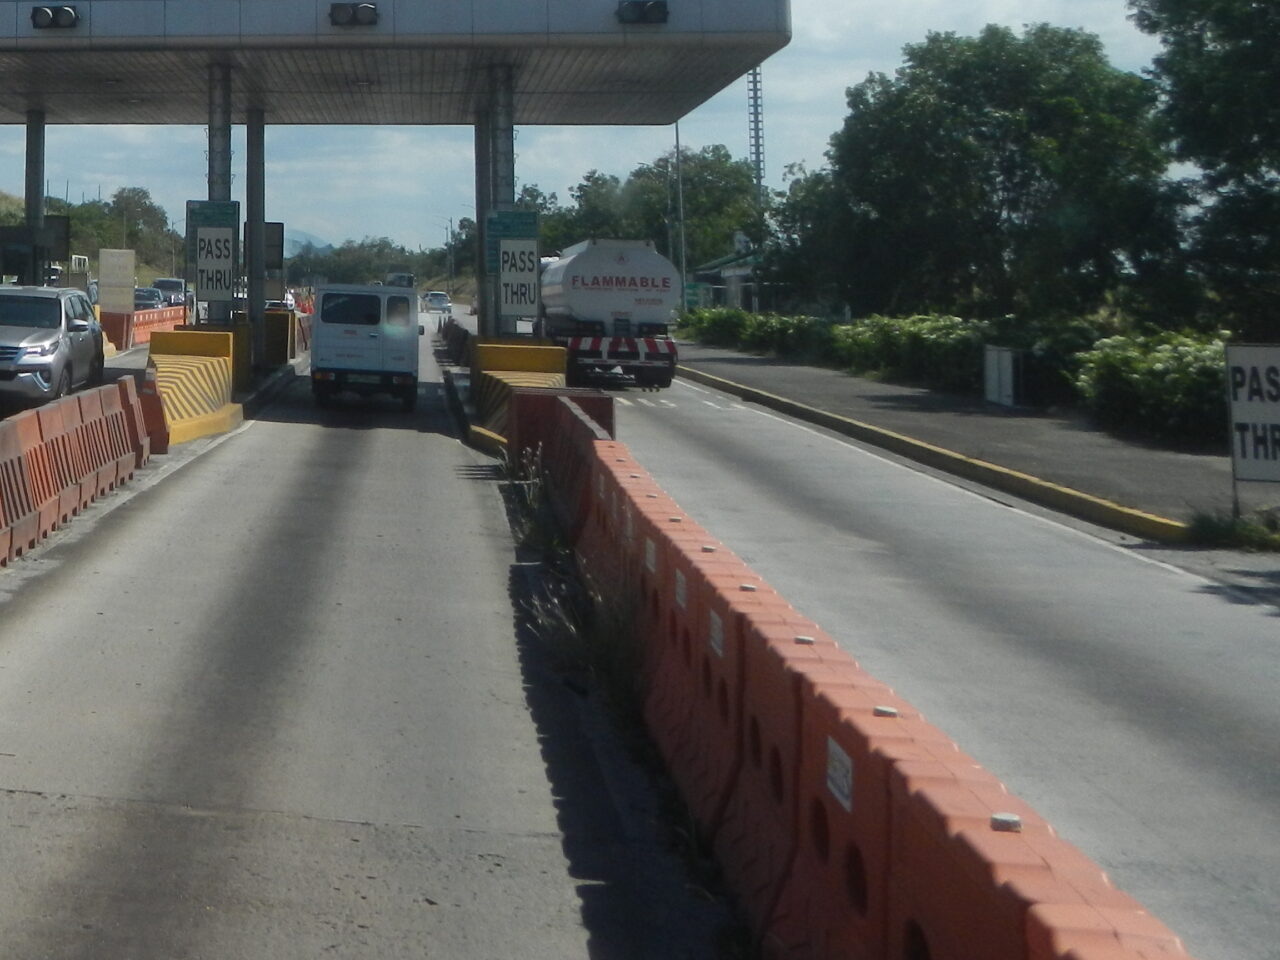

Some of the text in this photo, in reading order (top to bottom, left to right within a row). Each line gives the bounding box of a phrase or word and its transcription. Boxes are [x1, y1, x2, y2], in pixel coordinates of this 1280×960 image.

[198, 237, 231, 259] PASS
[501, 250, 535, 273] PASS
[198, 268, 232, 290] THRU
[571, 275, 671, 289] FLAMMABLE
[502, 282, 536, 305] THRU
